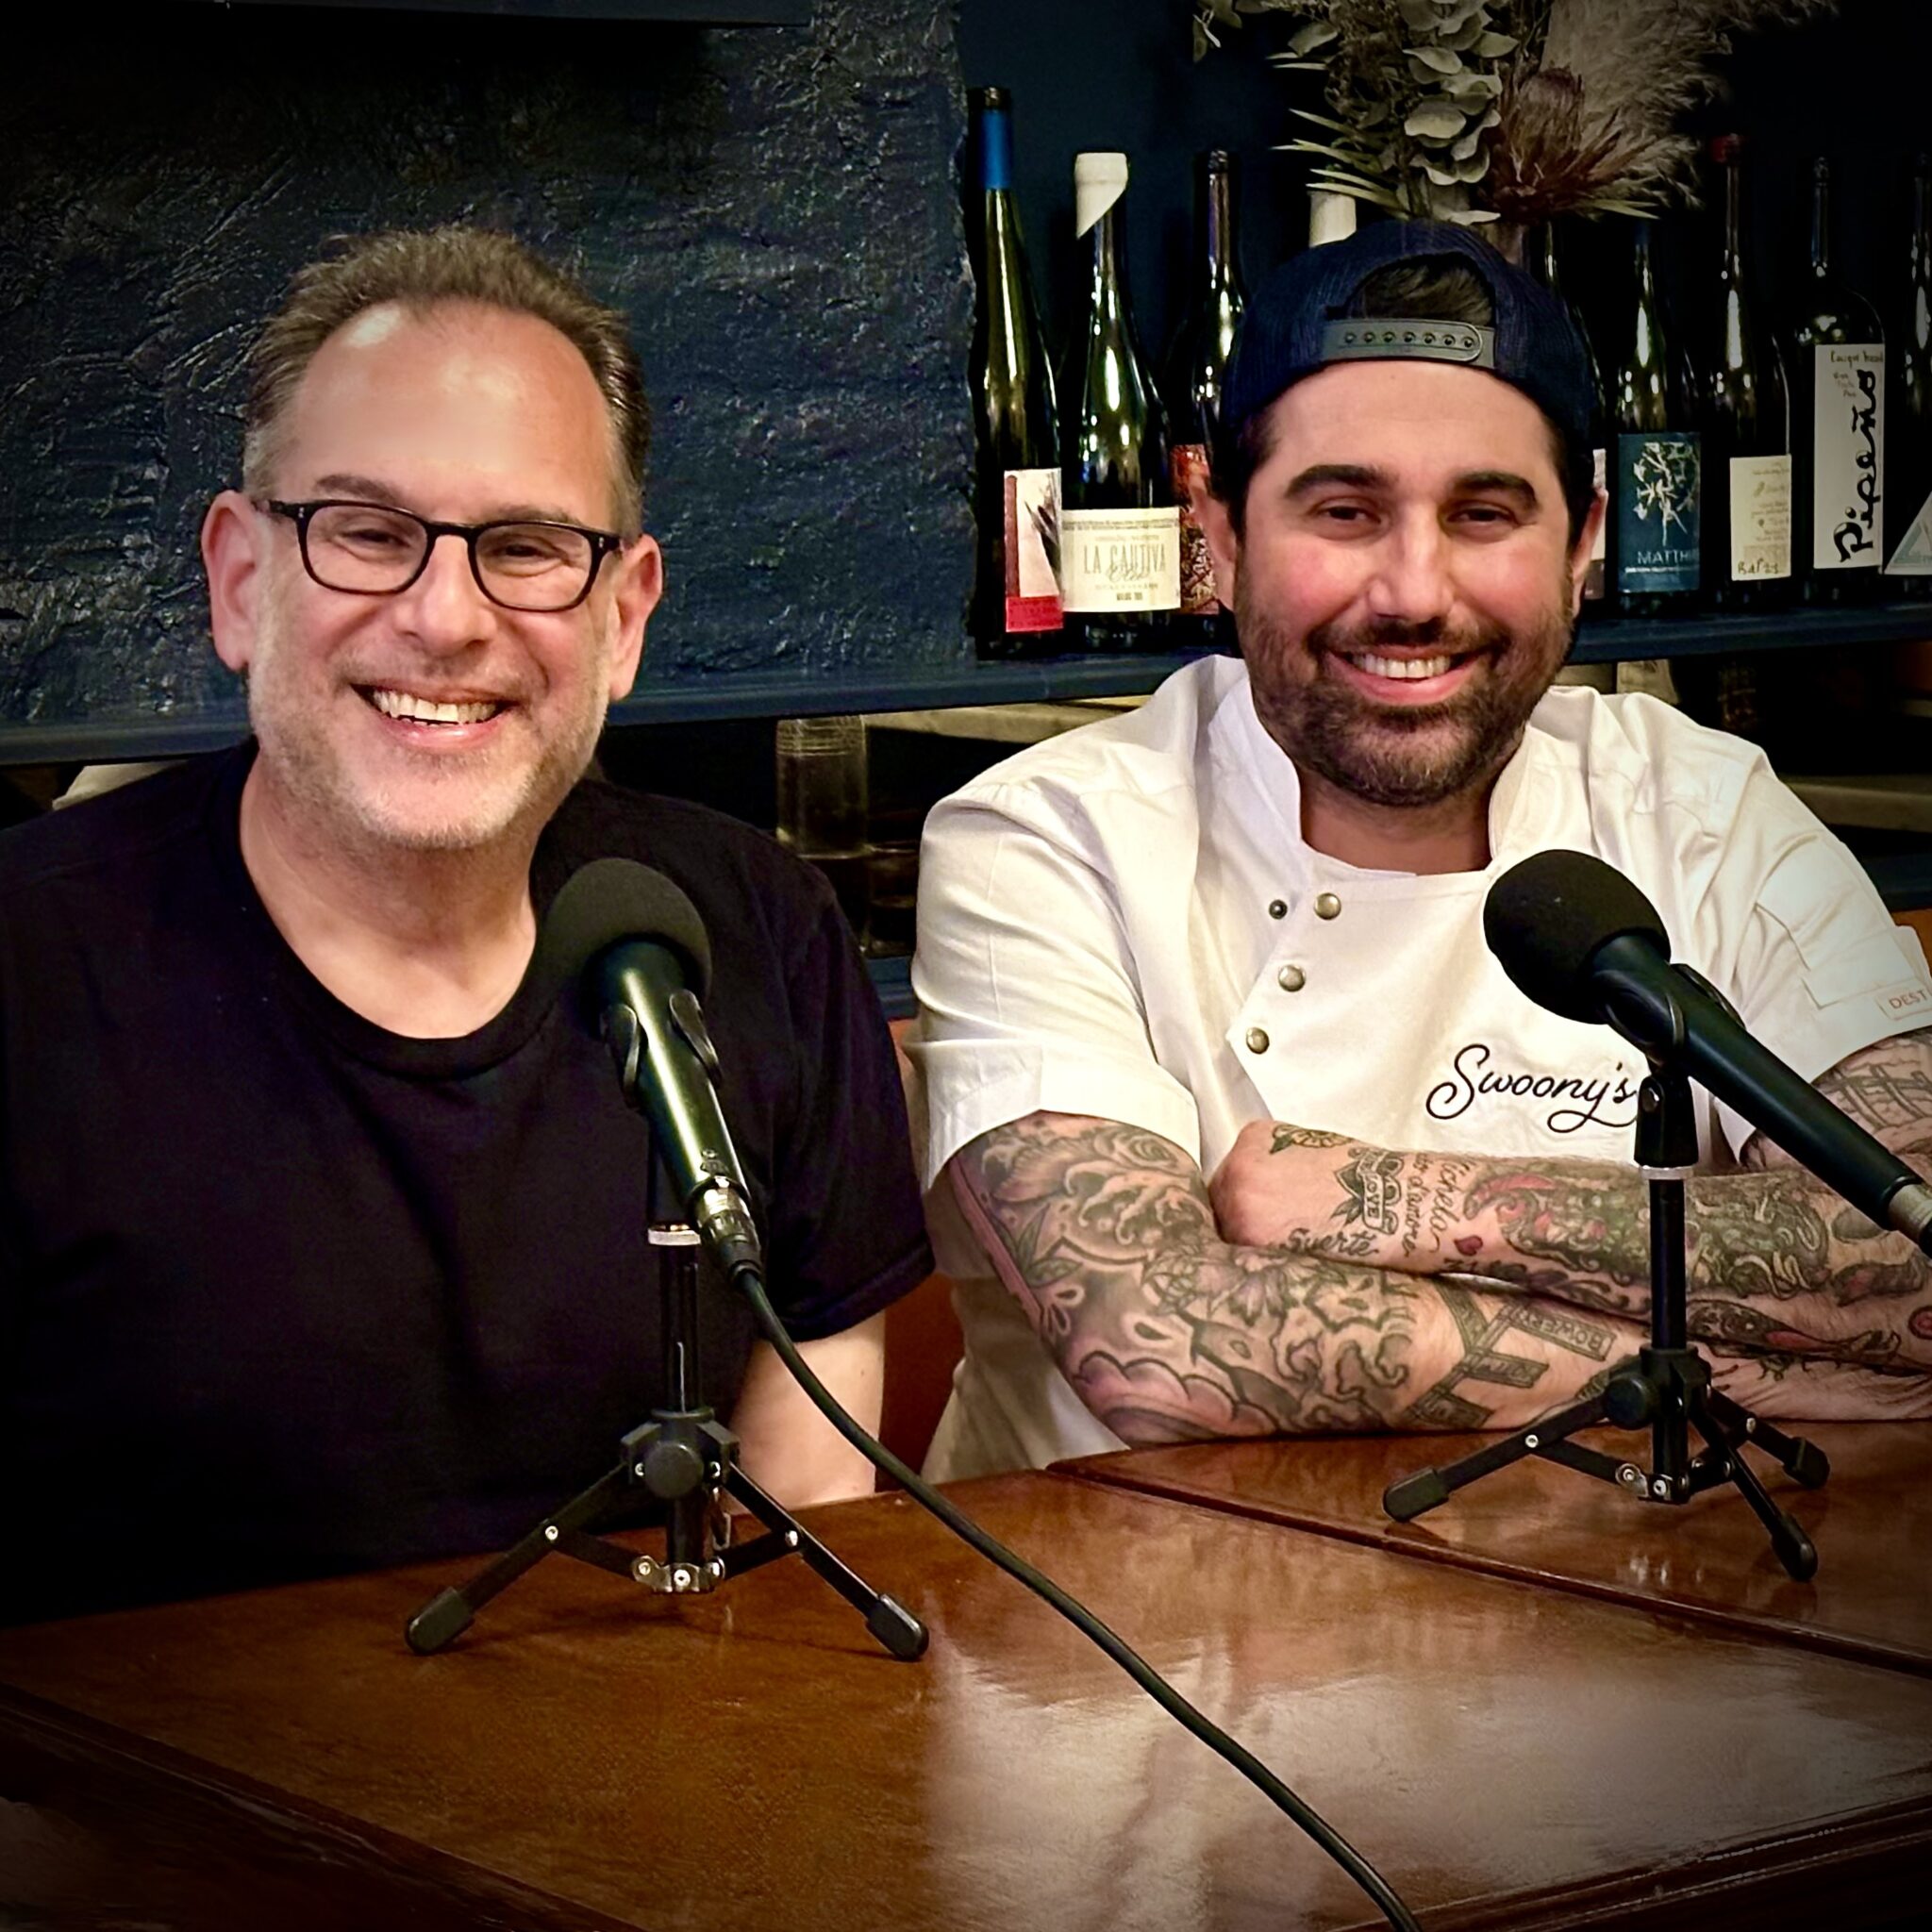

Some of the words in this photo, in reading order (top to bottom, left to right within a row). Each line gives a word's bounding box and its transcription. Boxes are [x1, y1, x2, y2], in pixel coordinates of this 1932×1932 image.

[1833, 368, 1881, 563] Pipeño
[1083, 544, 1102, 575] LA
[1425, 1043, 1638, 1134] Swoony's
[1364, 1174, 1381, 1219] LOVE
[1428, 1158, 1477, 1254] ichela
